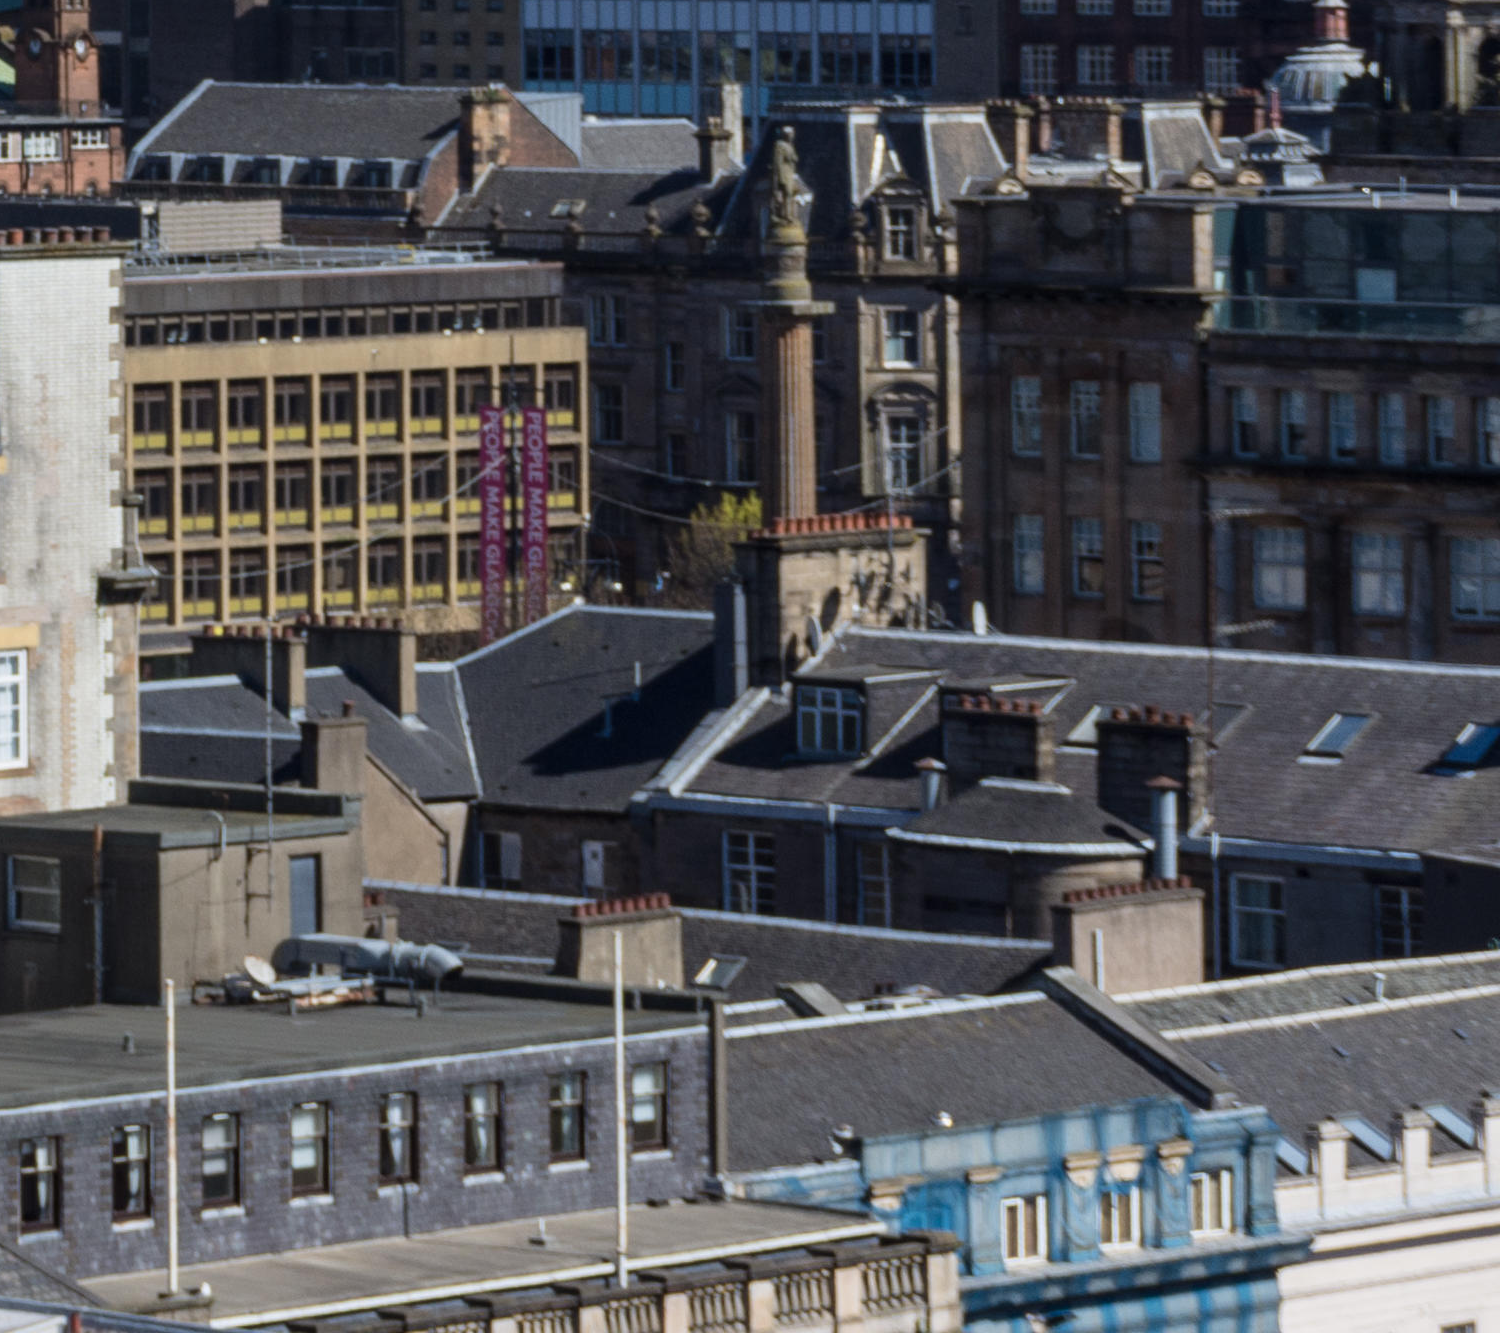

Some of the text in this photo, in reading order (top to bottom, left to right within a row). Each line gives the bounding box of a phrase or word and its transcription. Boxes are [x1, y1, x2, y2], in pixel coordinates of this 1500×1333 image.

[485, 411, 500, 480] PEOPLE
[486, 486, 501, 541] MAKE
[527, 411, 544, 624] PEOPLE MAKE GLASGO
